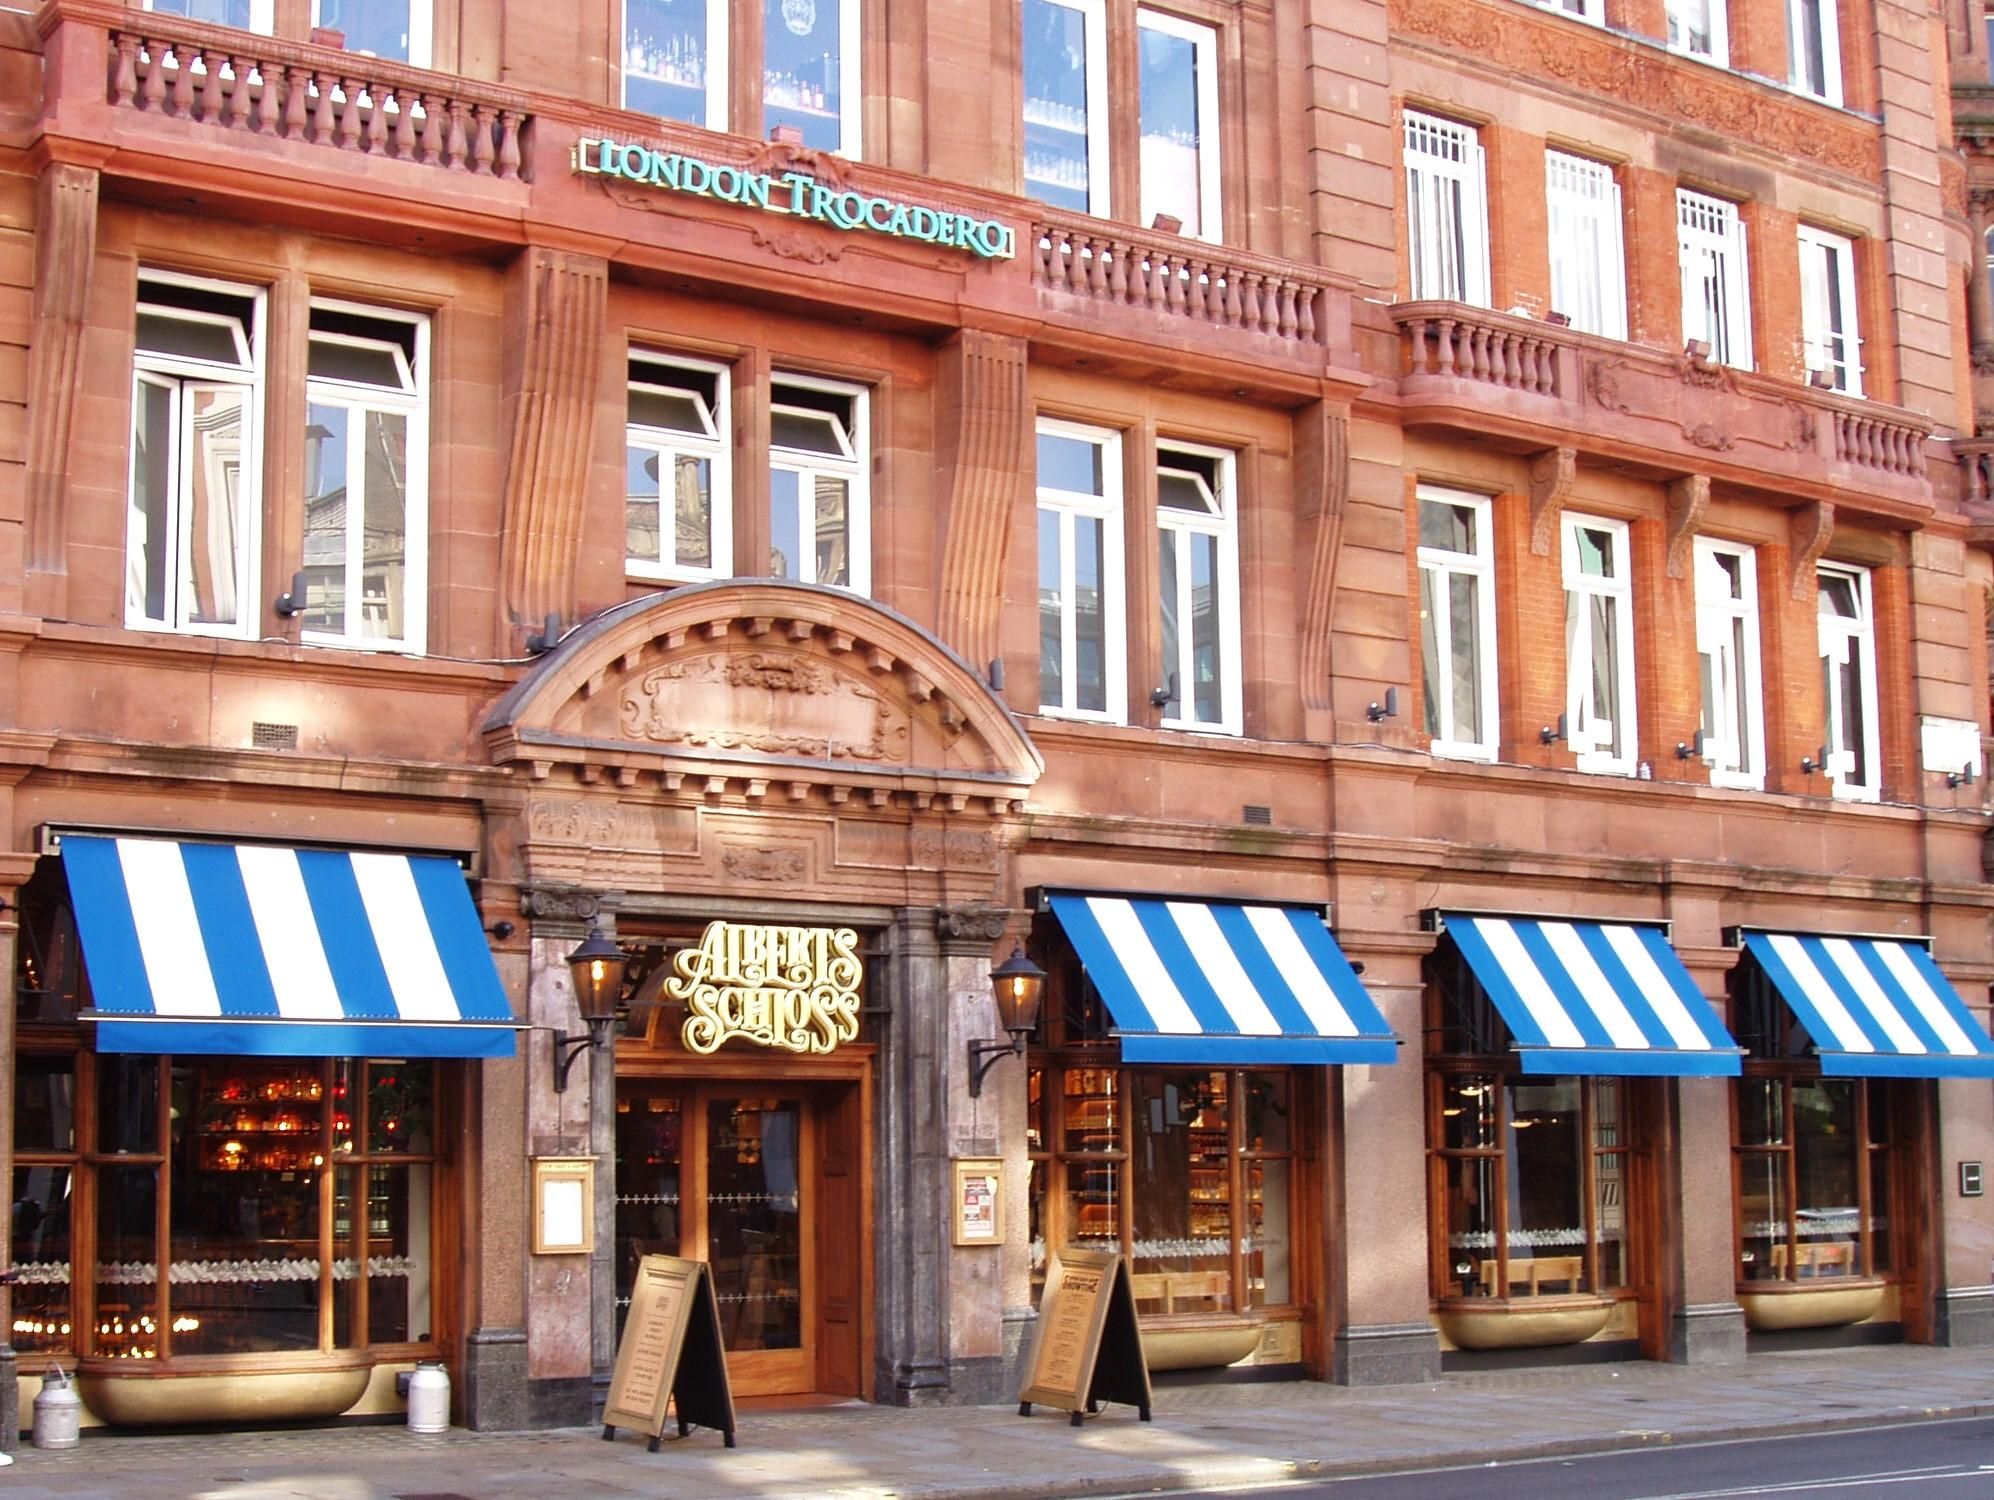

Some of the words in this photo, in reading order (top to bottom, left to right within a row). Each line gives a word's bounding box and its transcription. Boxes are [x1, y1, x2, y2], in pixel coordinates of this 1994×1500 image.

[599, 138, 772, 208] LONDON
[781, 172, 1008, 257] TROCADERO
[681, 984, 861, 1054] SCHLOSS
